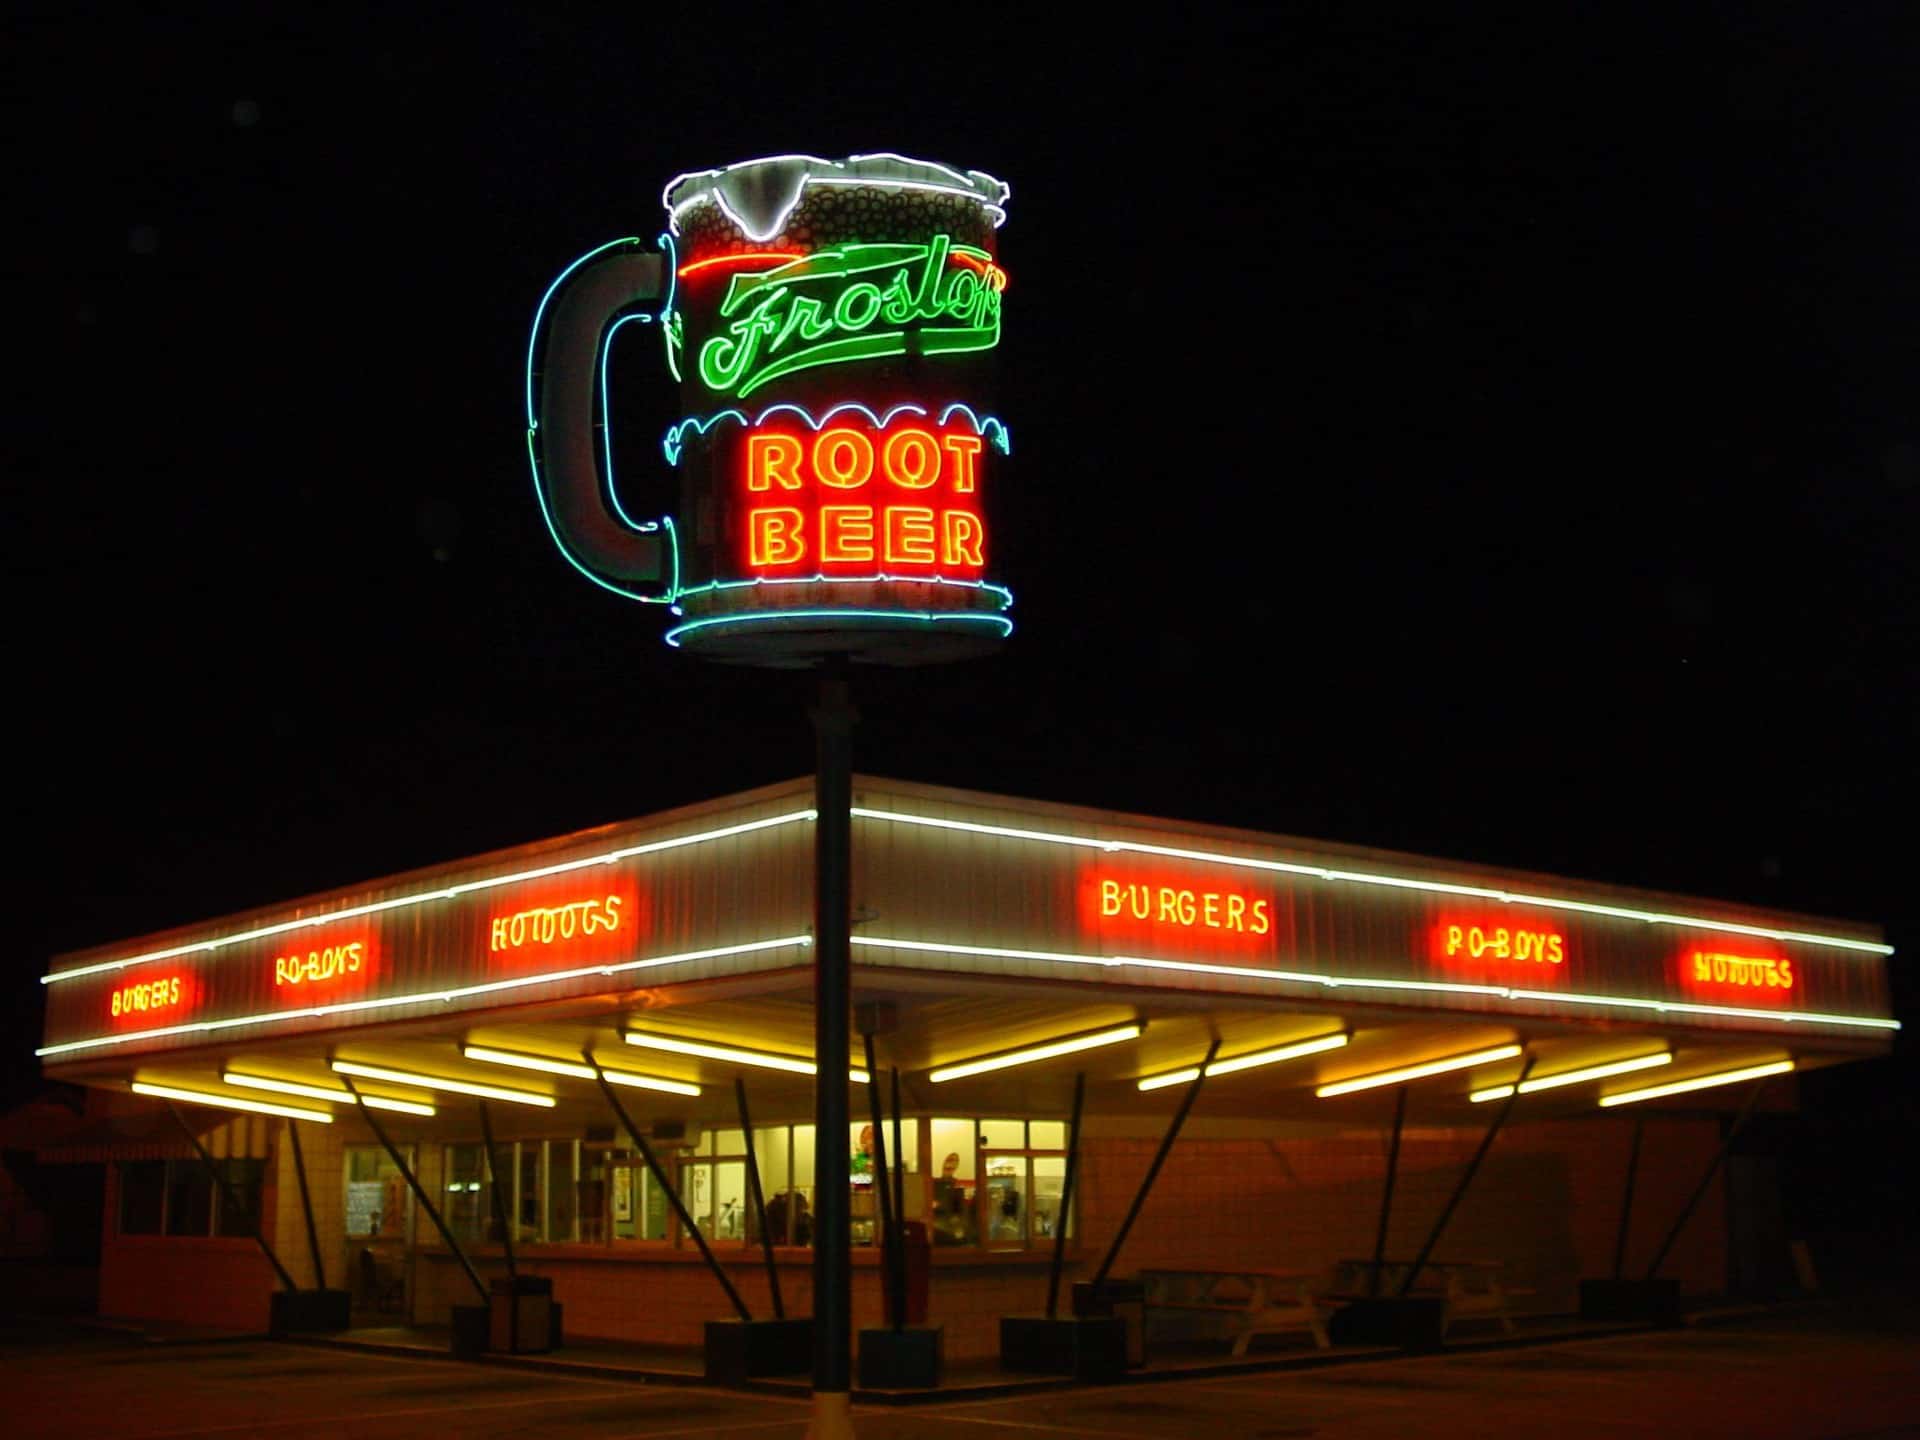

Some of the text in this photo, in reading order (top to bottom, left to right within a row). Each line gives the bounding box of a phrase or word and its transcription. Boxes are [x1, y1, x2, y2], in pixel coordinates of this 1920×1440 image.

[748, 428, 982, 493] ROOT
[750, 505, 984, 566] BEER
[1101, 879, 1270, 935] BURGERS
[1446, 924, 1564, 964] PO-BOYS
[111, 976, 181, 1017] BURGERS
